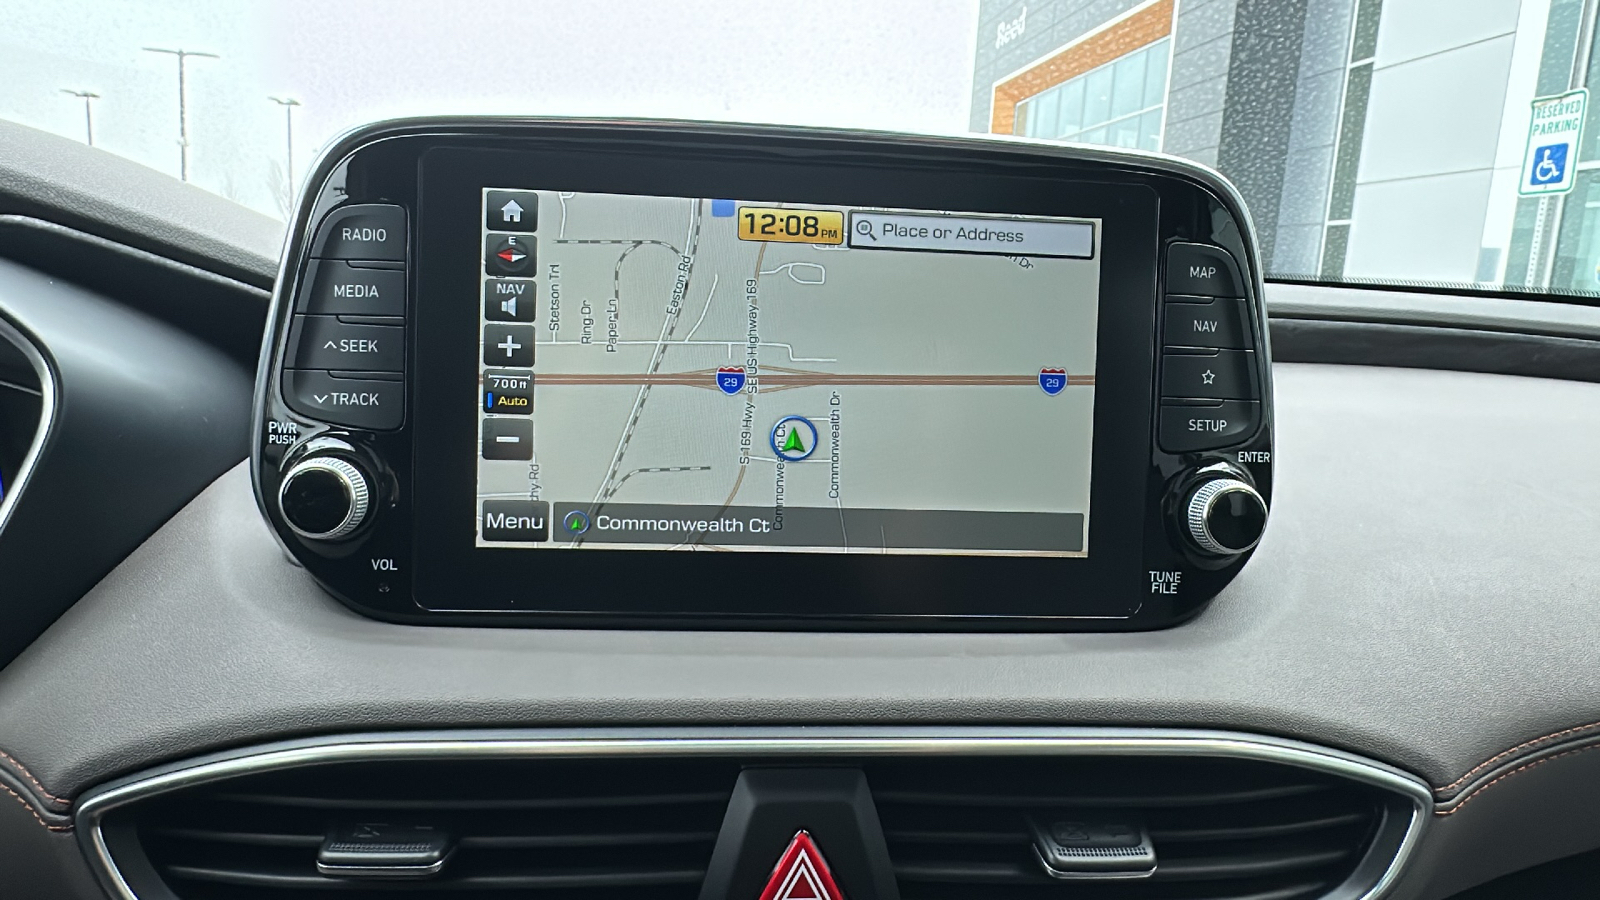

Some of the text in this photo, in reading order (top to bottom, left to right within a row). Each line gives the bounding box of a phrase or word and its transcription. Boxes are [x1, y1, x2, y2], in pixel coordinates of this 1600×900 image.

[1536, 100, 1581, 119] RESERVED
[1532, 118, 1579, 136] PARKING
[745, 213, 838, 239] 12:08 PM
[342, 228, 387, 242] RADIO
[883, 223, 1024, 243] Place or Address
[508, 236, 517, 245] E
[1019, 257, 1034, 269] Dr
[1190, 266, 1217, 279] MAP
[334, 285, 379, 298] MEDIA
[496, 284, 525, 295] NAV
[666, 255, 691, 315] Easton Rd
[549, 283, 560, 331] Stetson
[581, 300, 594, 344] Ring Dr
[606, 299, 619, 352] Paper Ln
[1193, 320, 1218, 332] NAV
[746, 279, 760, 394] SE US Highway 169
[340, 340, 378, 352] SEEK
[724, 378, 738, 387] 29
[1046, 378, 1059, 388] 29
[331, 393, 379, 405] TRACK
[498, 396, 528, 406] Auto
[268, 421, 298, 434] PWR
[1188, 419, 1228, 431] SETUP
[269, 435, 297, 444] PUSH
[740, 402, 756, 465] S 169 Hwy
[829, 391, 840, 499] Commonwealth Dr
[1238, 452, 1271, 463] ENTER
[528, 464, 540, 480] Rd
[773, 424, 786, 531] Commonweah Ct
[486, 513, 543, 529] Menu
[597, 515, 770, 533] Commonwealth Ct
[371, 559, 398, 571] VOL
[1149, 571, 1182, 583] TUNE
[1152, 583, 1178, 594] FILE
